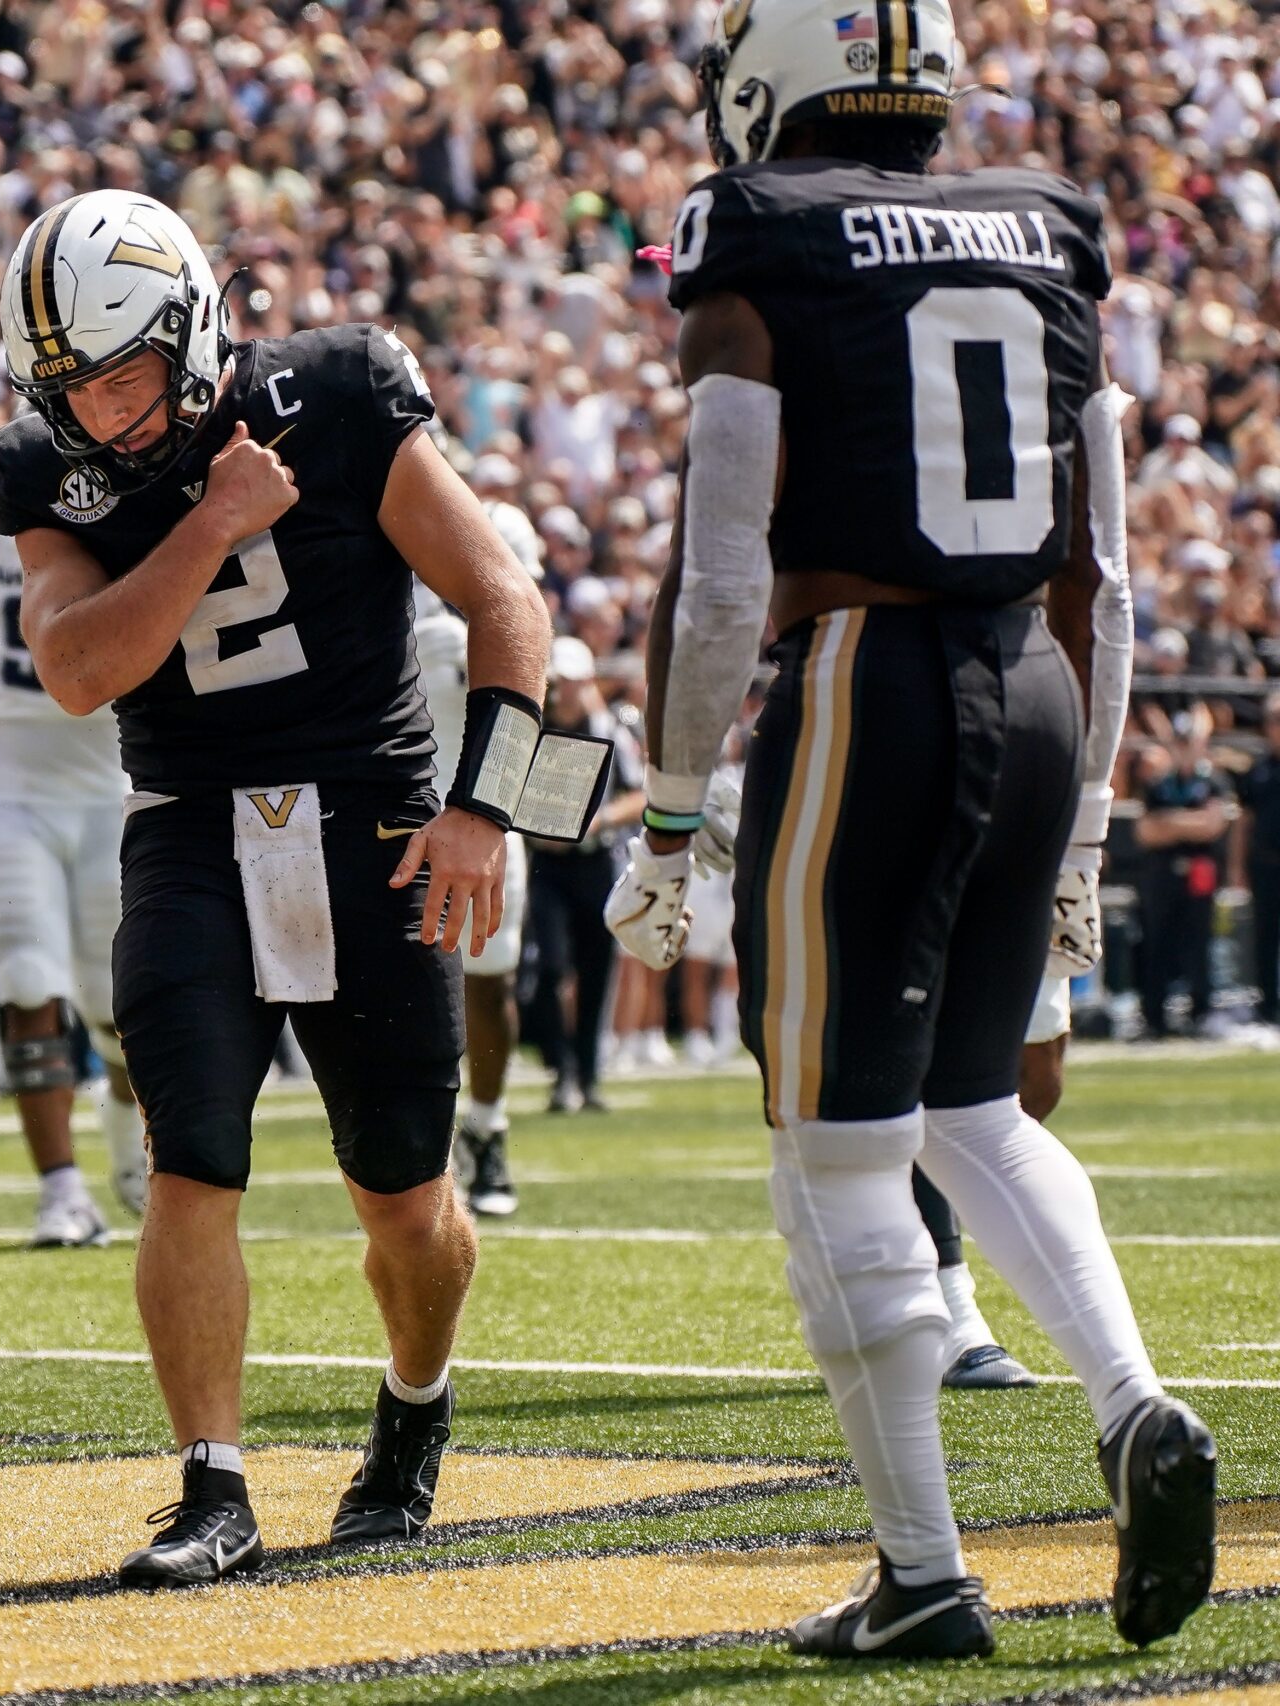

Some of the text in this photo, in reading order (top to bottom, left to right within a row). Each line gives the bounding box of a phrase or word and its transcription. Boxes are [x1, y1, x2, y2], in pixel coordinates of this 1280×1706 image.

[824, 92, 952, 116] VANDERBIL
[842, 205, 1065, 271] SHERRILL
[34, 355, 77, 378] VUFB
[267, 368, 302, 417] C
[906, 286, 1055, 557] 0
[60, 502, 112, 522] GRADUATE
[180, 529, 309, 696] 2
[246, 788, 304, 829] V
